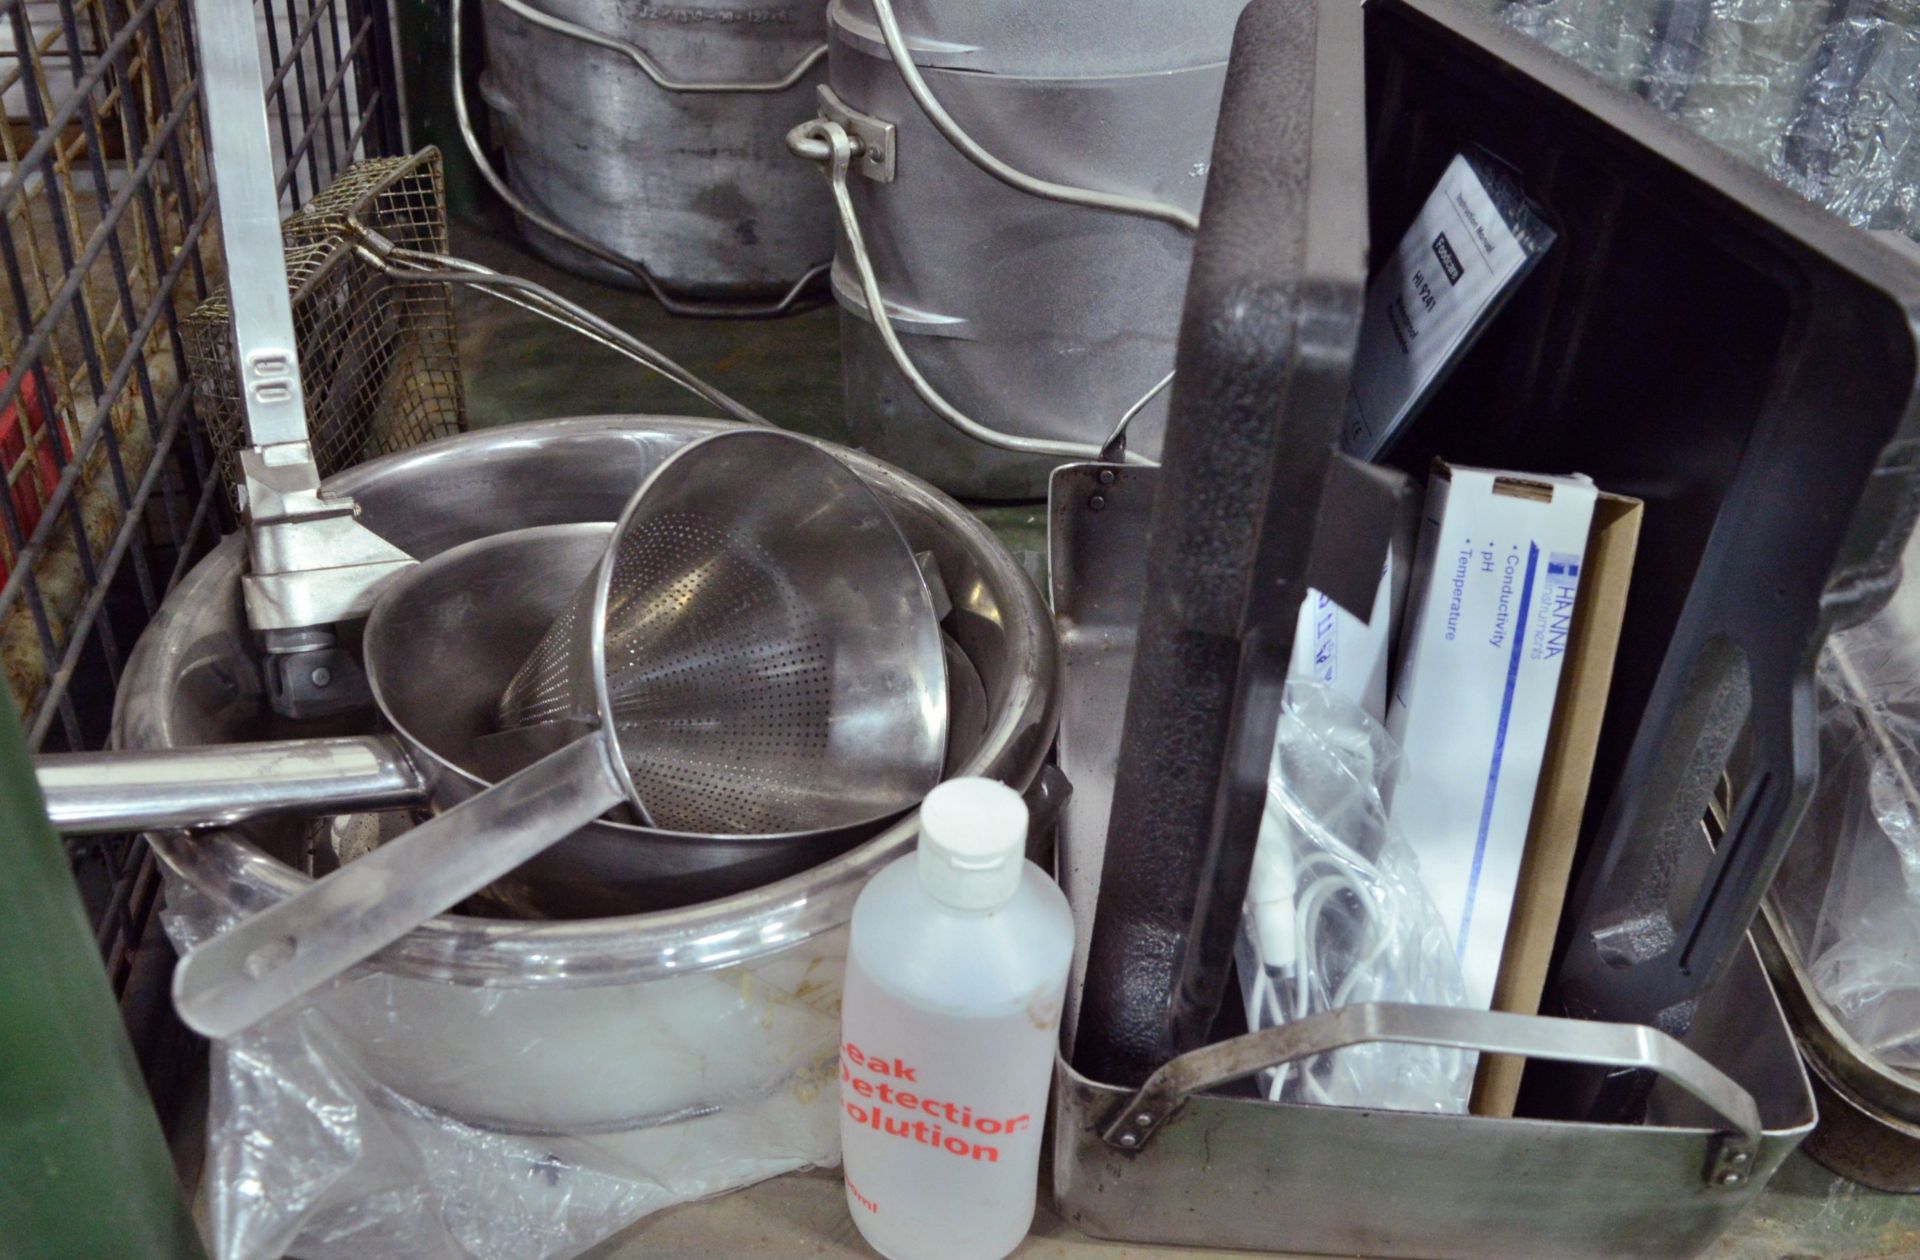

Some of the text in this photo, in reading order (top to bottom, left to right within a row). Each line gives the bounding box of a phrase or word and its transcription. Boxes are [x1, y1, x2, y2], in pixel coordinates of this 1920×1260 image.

[1434, 236, 1460, 282] Foodcare
[1475, 226, 1495, 254] Manual
[1412, 270, 1437, 314] HI 9241
[1481, 551, 1496, 573] pH
[1445, 549, 1473, 641] Temperature
[1489, 554, 1520, 649] Conductivity
[1543, 586, 1576, 660] HANNA
[843, 1042, 917, 1083] eak
[841, 1096, 999, 1163] olution
